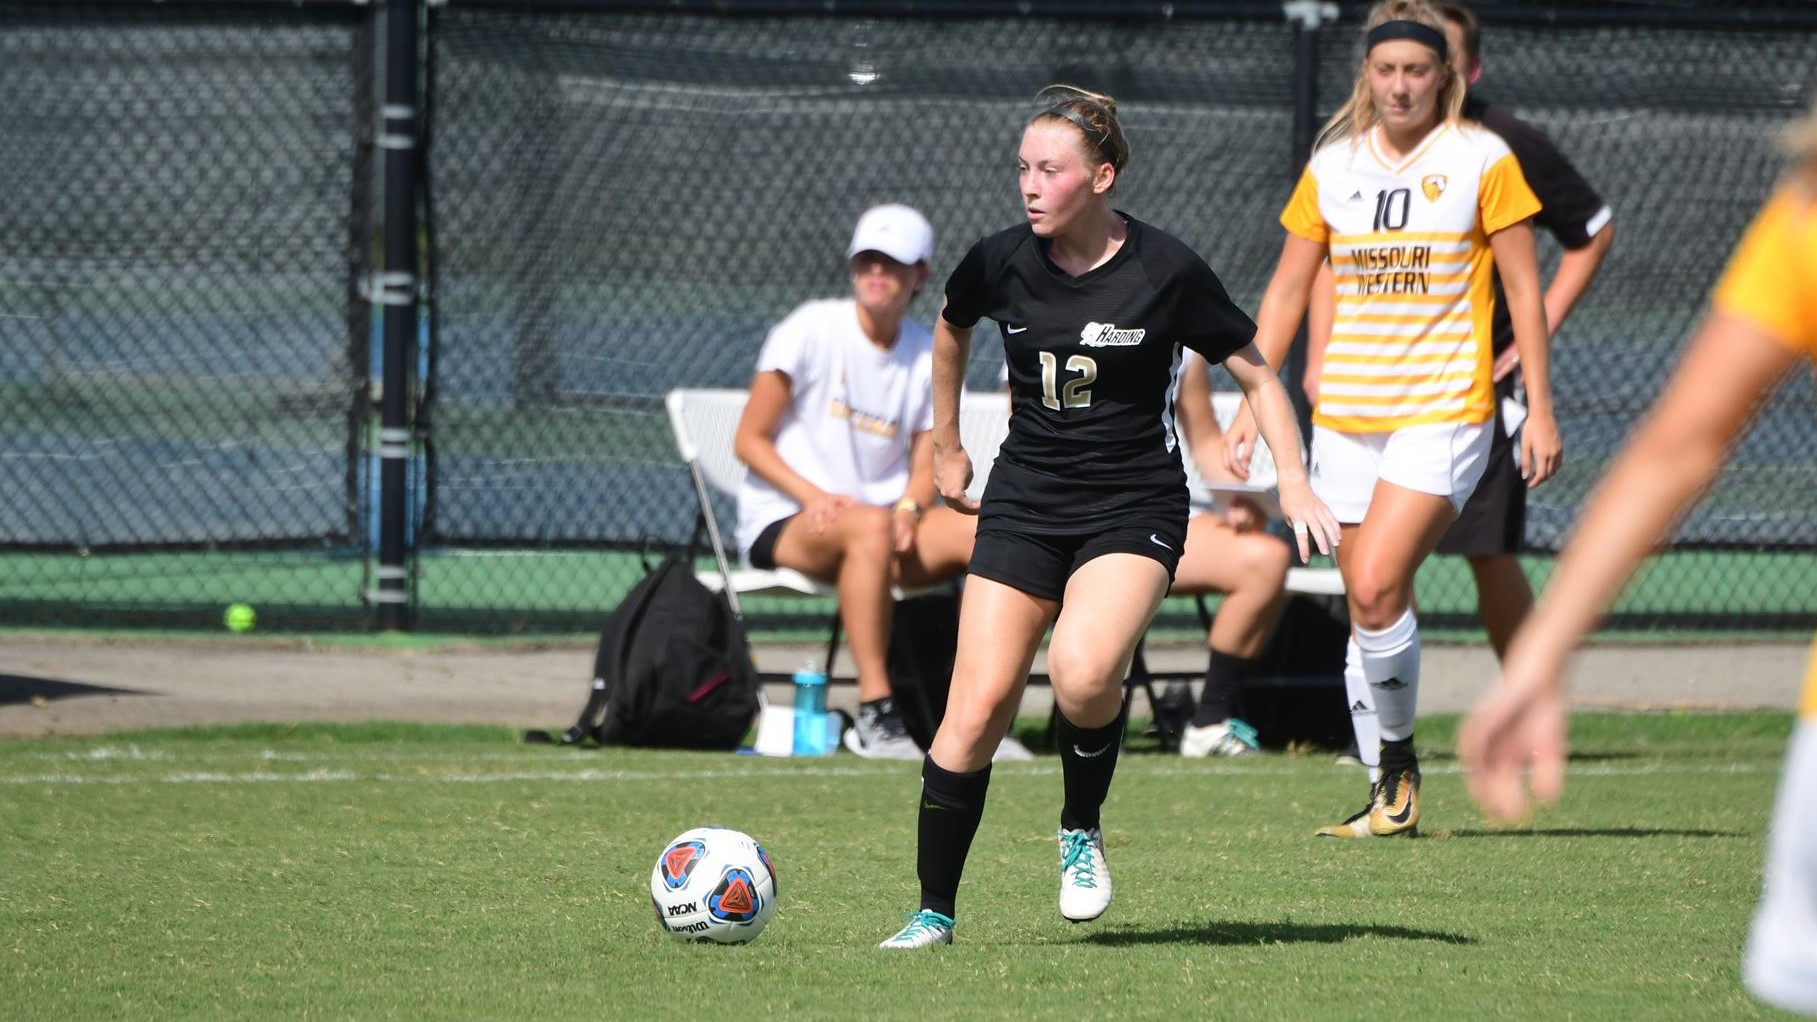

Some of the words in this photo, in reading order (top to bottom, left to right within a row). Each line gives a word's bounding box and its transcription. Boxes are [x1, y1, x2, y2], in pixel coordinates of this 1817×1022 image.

[1373, 188, 1411, 232] 10
[1352, 246, 1431, 271] MISSOURI
[1095, 326, 1143, 344] HARDING
[1039, 351, 1097, 411] 12
[667, 902, 697, 916] NCAA
[671, 921, 710, 934] Wilson
